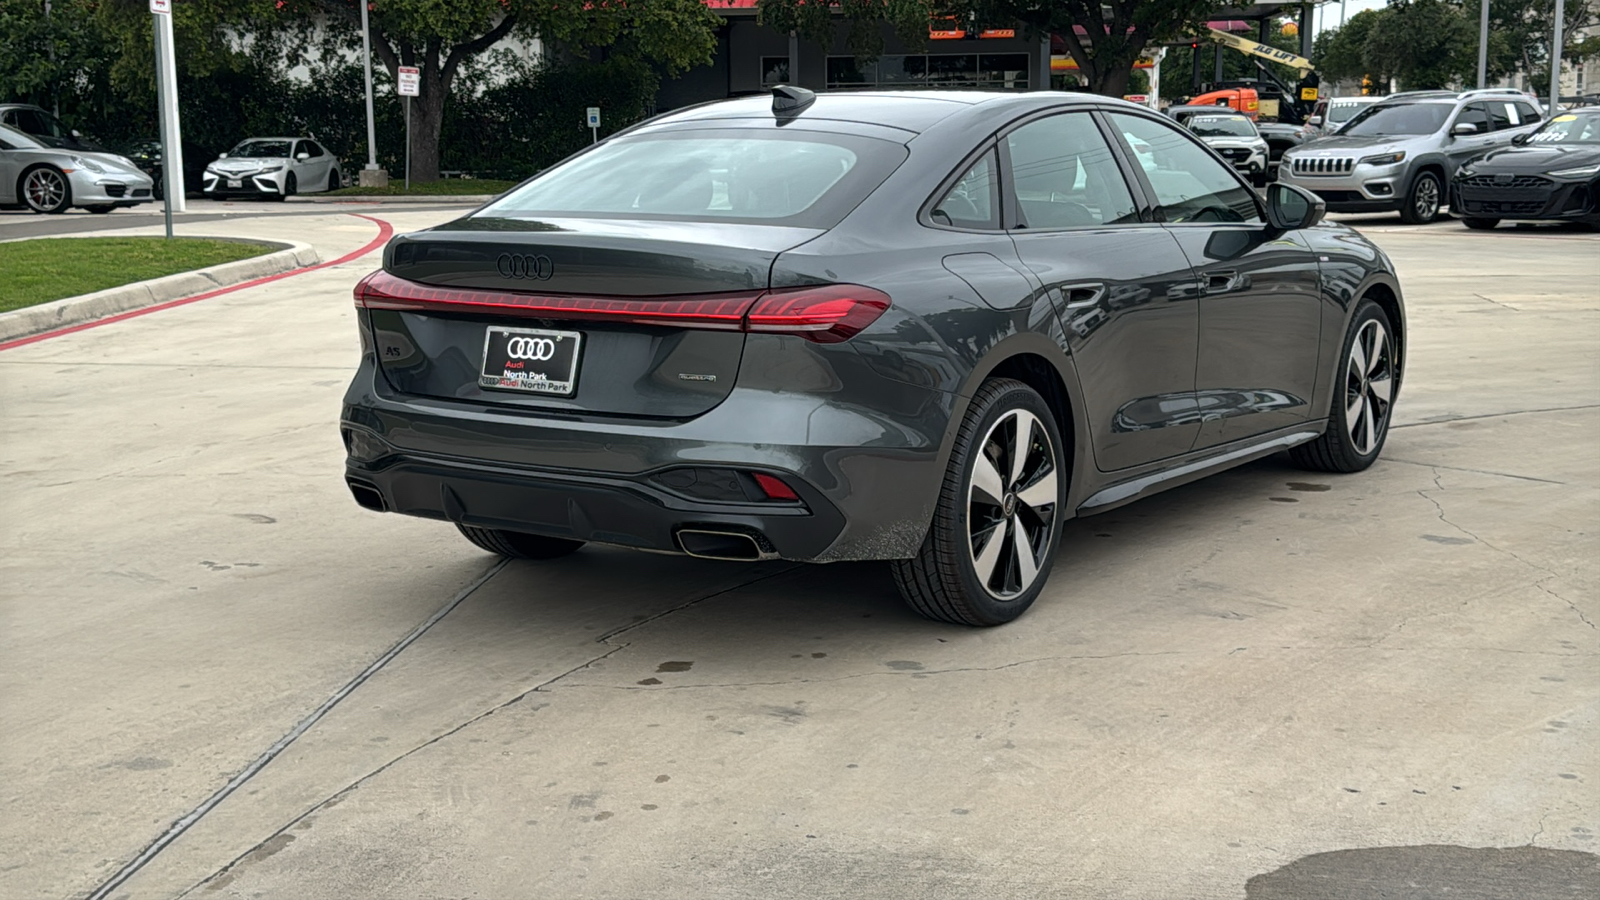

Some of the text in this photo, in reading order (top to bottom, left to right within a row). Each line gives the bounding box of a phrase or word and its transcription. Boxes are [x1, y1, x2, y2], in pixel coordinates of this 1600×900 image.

[1253, 44, 1298, 63] JLG LIFT
[386, 346, 401, 357] A5
[505, 360, 525, 369] Audi
[503, 370, 548, 382] North Park
[499, 378, 568, 393] Audi North Park
